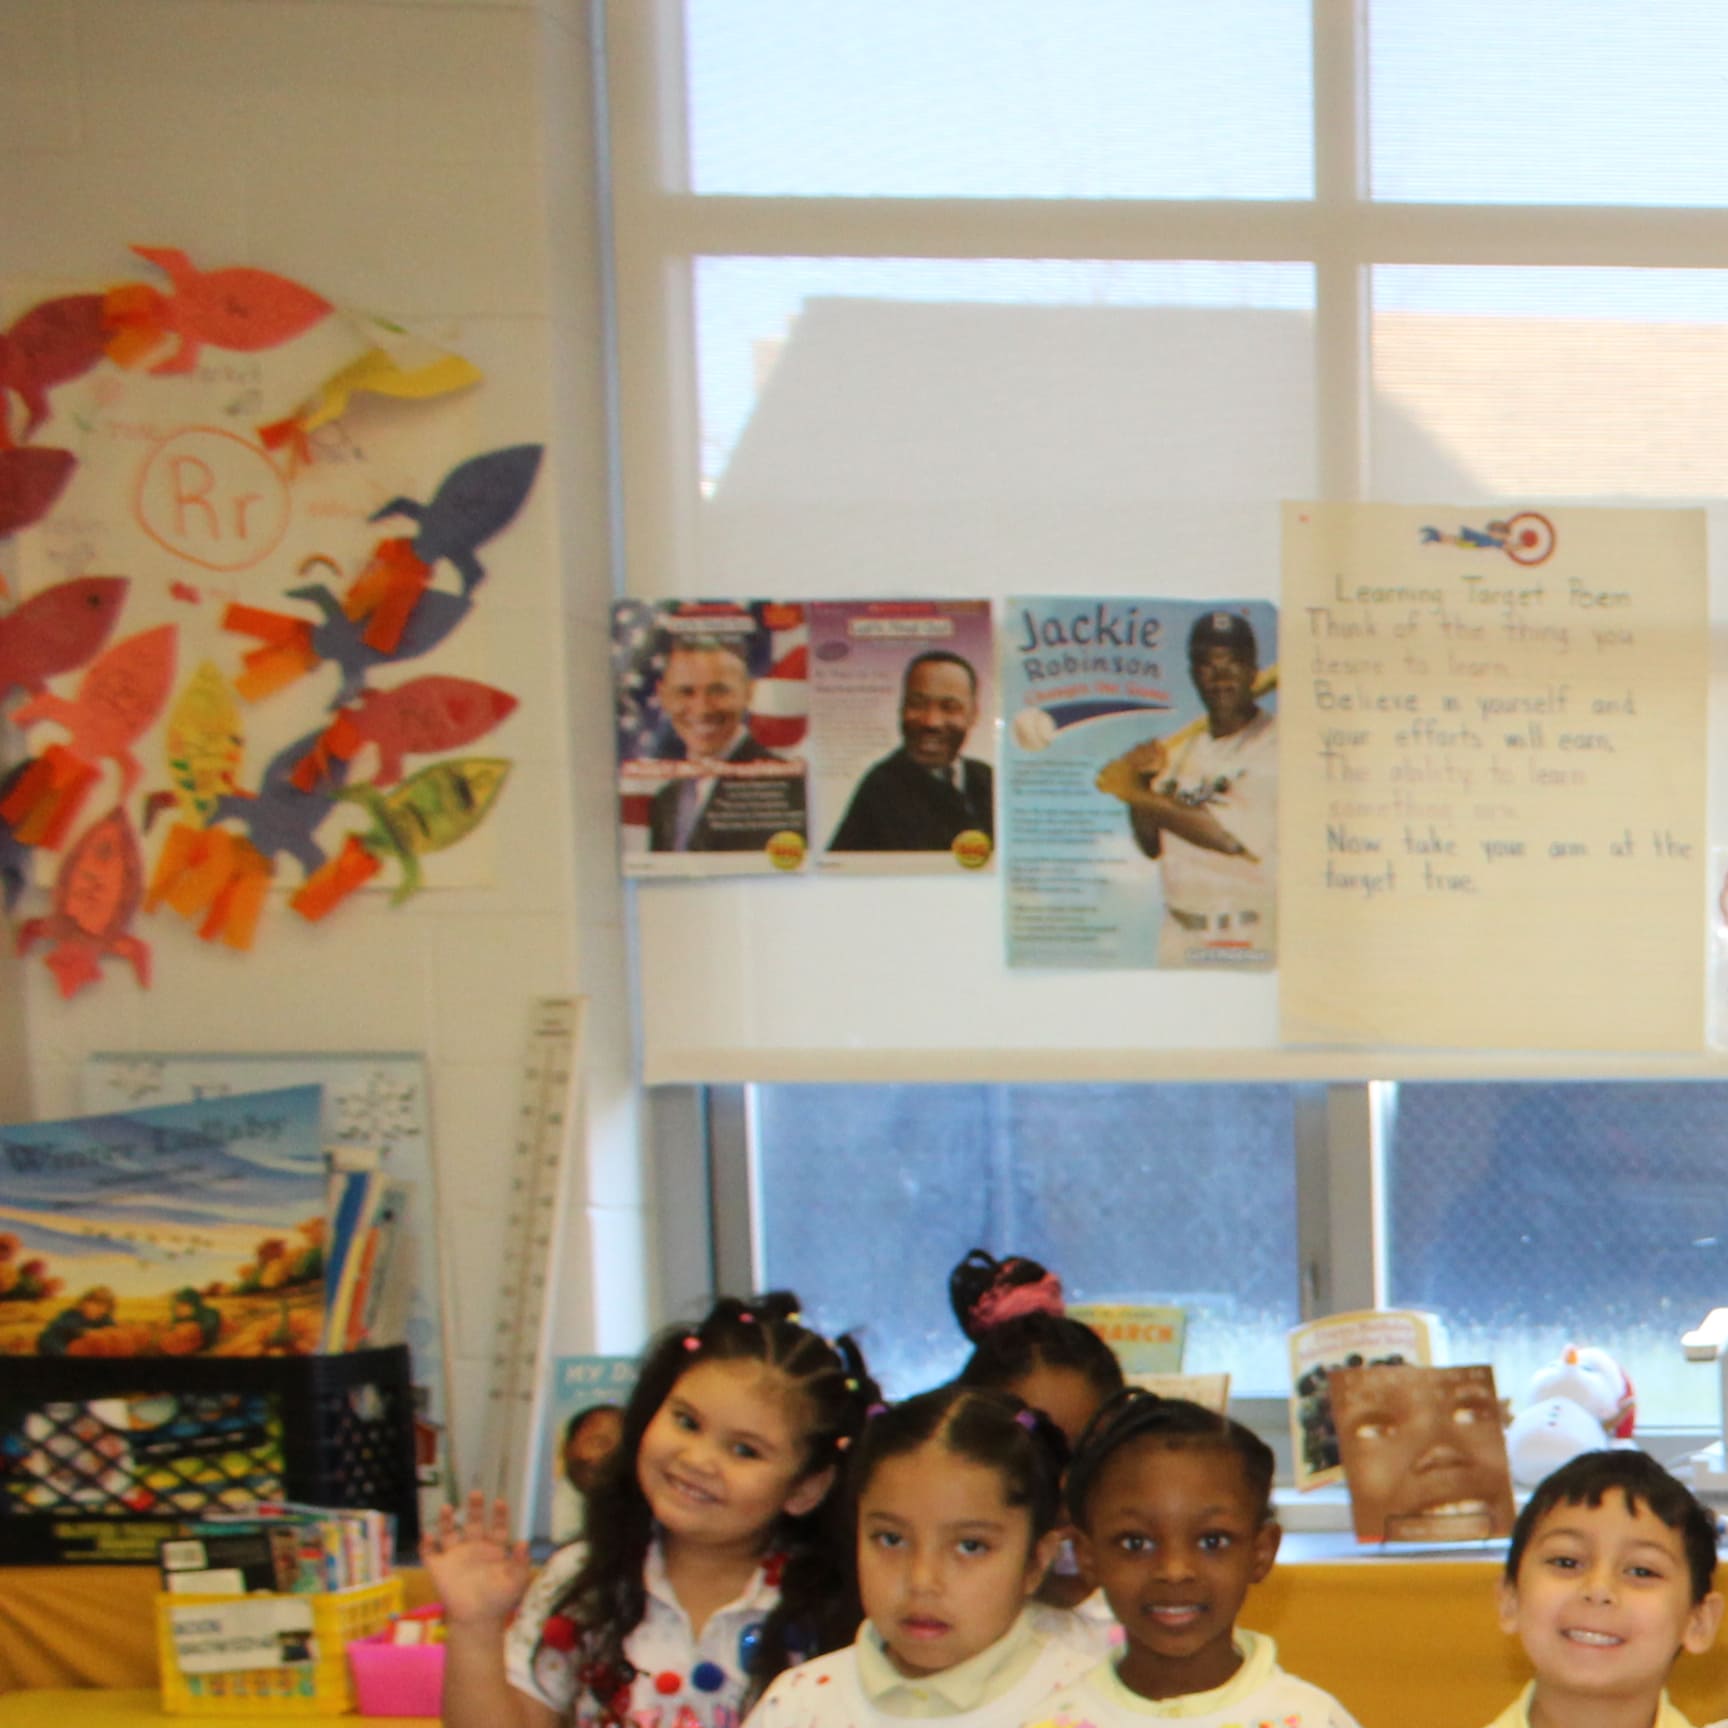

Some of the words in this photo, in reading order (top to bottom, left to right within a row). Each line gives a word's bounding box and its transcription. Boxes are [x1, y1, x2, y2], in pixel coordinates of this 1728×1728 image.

[168, 454, 264, 540] Rr
[1334, 574, 1447, 614] Learning
[1461, 575, 1545, 615] Target
[1567, 577, 1632, 609] Poem
[1019, 604, 1162, 652] Jackie
[1307, 608, 1376, 639] Think
[1392, 611, 1420, 639] of
[1437, 610, 1486, 641] the
[1503, 614, 1570, 654] thing
[1592, 626, 1636, 649] you
[1022, 651, 1162, 682] Robinson
[1314, 679, 1418, 712] Believe
[1476, 685, 1570, 721] yourself
[1590, 690, 1637, 716] and
[1393, 718, 1483, 750] efforts
[1325, 823, 1380, 854] Now
[1404, 827, 1458, 857] take
[1609, 832, 1634, 858] at
[1652, 830, 1694, 860] the
[1324, 863, 1397, 899] target
